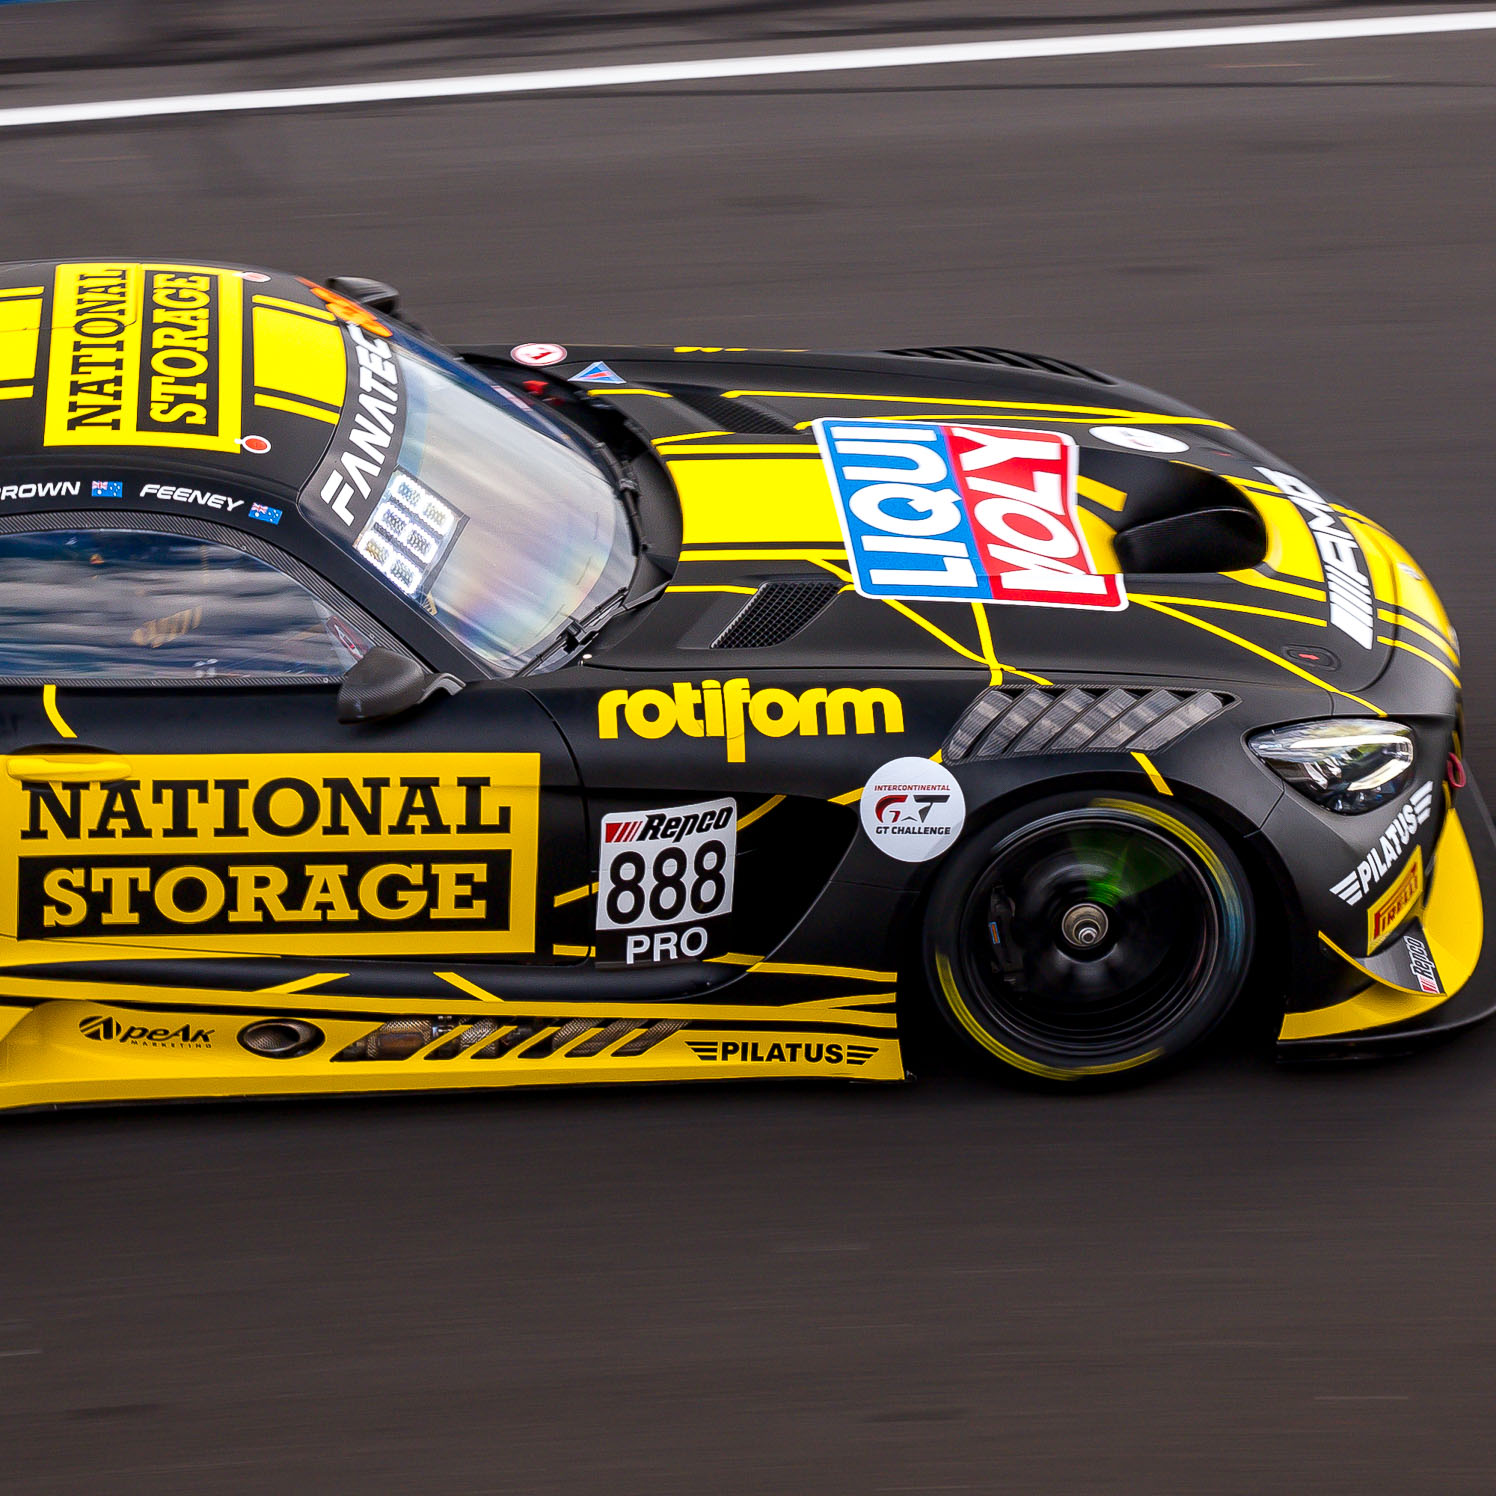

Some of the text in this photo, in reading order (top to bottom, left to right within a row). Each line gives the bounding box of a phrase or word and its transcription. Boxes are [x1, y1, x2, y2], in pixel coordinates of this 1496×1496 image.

[67, 269, 126, 431] NATIONAL
[149, 273, 211, 425] STORAGE
[290, 320, 399, 527] FANATEC
[140, 484, 245, 512] FEENEY
[829, 426, 980, 587] LIQUI
[951, 427, 1109, 595] MOLY
[598, 678, 905, 763] rotiform
[20, 777, 512, 840] NATIONAL
[636, 806, 734, 843] Repco
[875, 826, 951, 835] GT CHALLENGE
[606, 839, 727, 925] 888
[1357, 804, 1419, 895] PILATUS
[42, 862, 488, 928] STORAGE
[1373, 861, 1419, 940] PIRELLI
[626, 926, 708, 965] PRO
[1406, 936, 1435, 981] Repco
[130, 1039, 212, 1049] MARKETING
[721, 1041, 844, 1064] PILATUS
